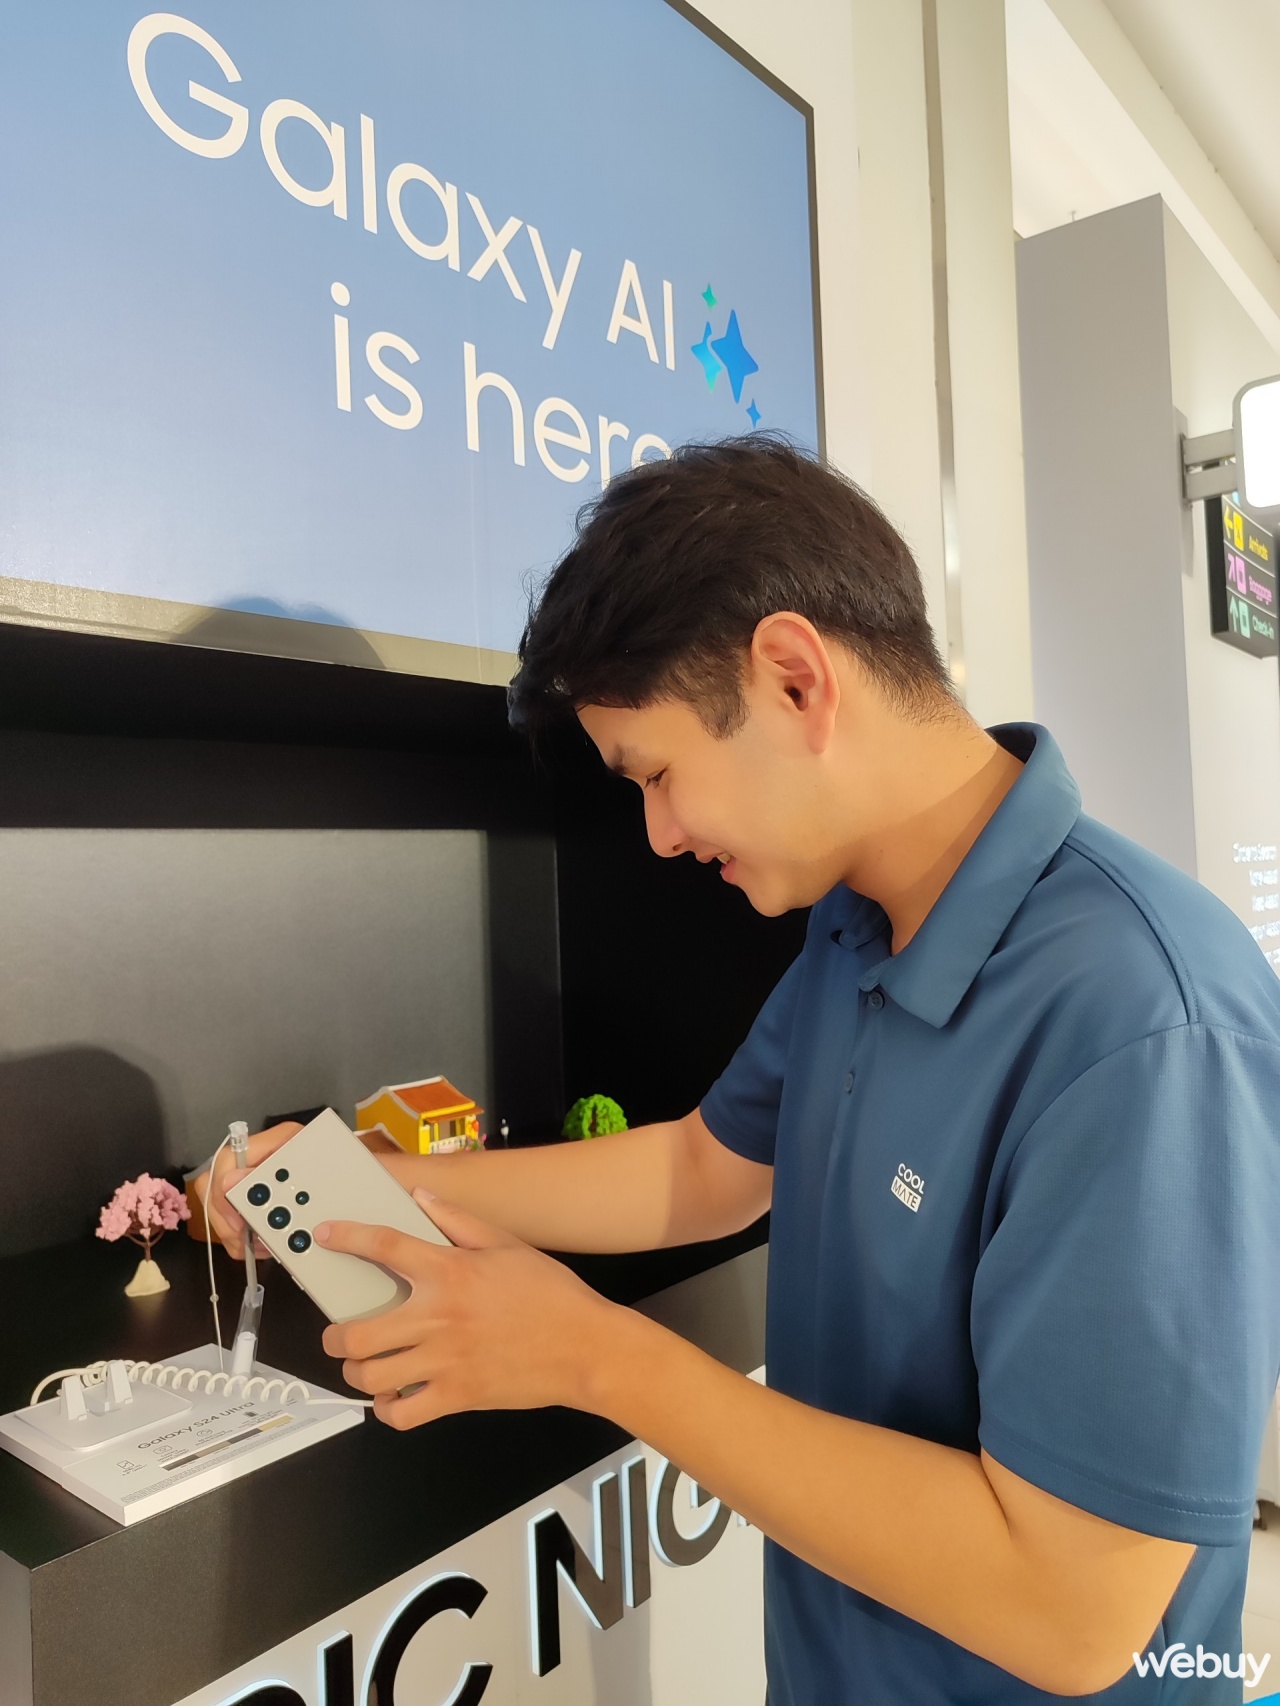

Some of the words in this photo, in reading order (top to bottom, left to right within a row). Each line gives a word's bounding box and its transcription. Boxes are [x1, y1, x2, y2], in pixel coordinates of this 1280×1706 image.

[128, 13, 582, 350] Galaxy
[606, 258, 676, 372] AI
[330, 281, 424, 431] is
[892, 1179, 918, 1209] MATE
[897, 1162, 925, 1195] COOL
[137, 1424, 193, 1450] Galaxy
[193, 1413, 220, 1429] S24
[220, 1401, 256, 1417] Ultra
[527, 1453, 750, 1678] NIG
